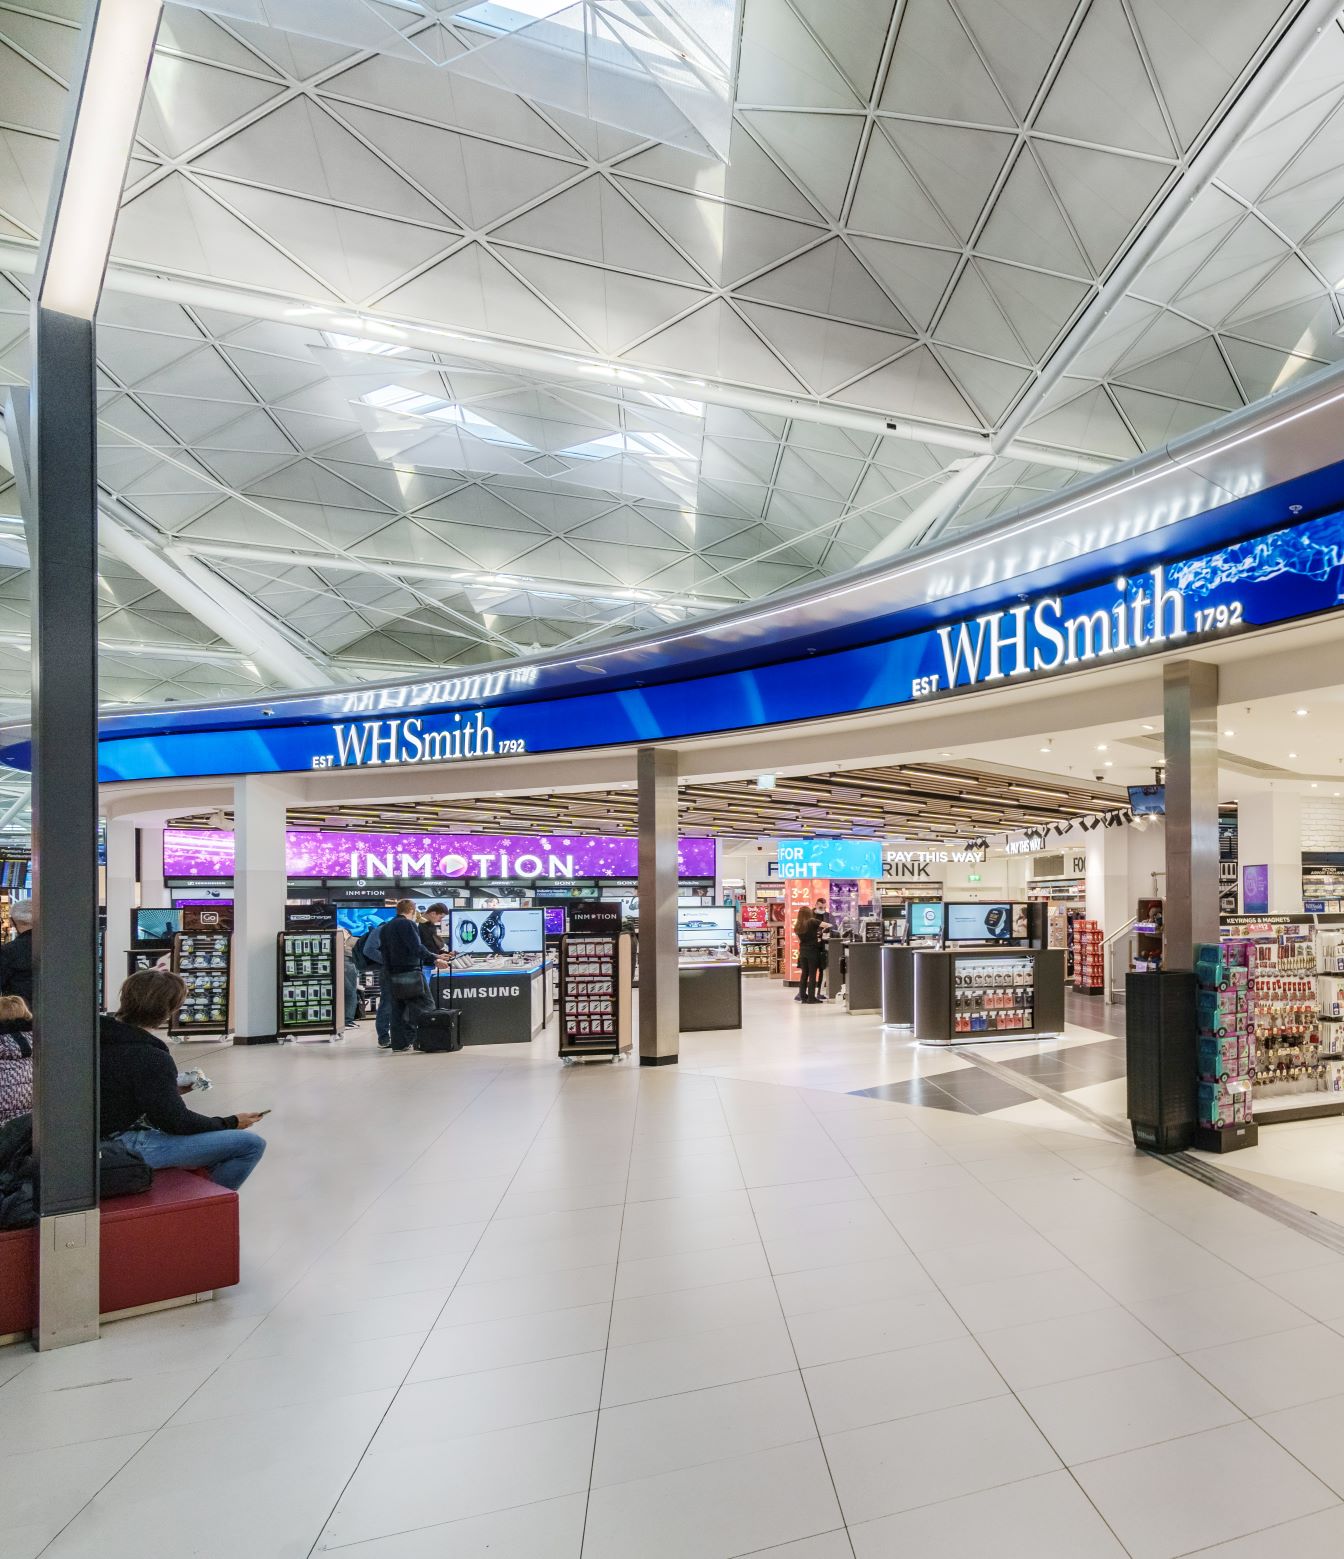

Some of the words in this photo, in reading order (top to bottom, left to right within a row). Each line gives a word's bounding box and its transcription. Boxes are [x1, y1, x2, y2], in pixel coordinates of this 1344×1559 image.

[912, 674, 939, 697] EST
[936, 565, 1187, 689] WHSmith
[1194, 601, 1243, 634] 1792
[312, 754, 334, 768] EST
[332, 711, 495, 767] WHSmith
[498, 739, 526, 754] 1792
[888, 851, 913, 862] PAY
[917, 851, 948, 862] THIS
[952, 851, 984, 862] WAY
[882, 862, 930, 877] RINK
[203, 913, 216, 921] Go
[442, 986, 520, 999] SAMSUNG
